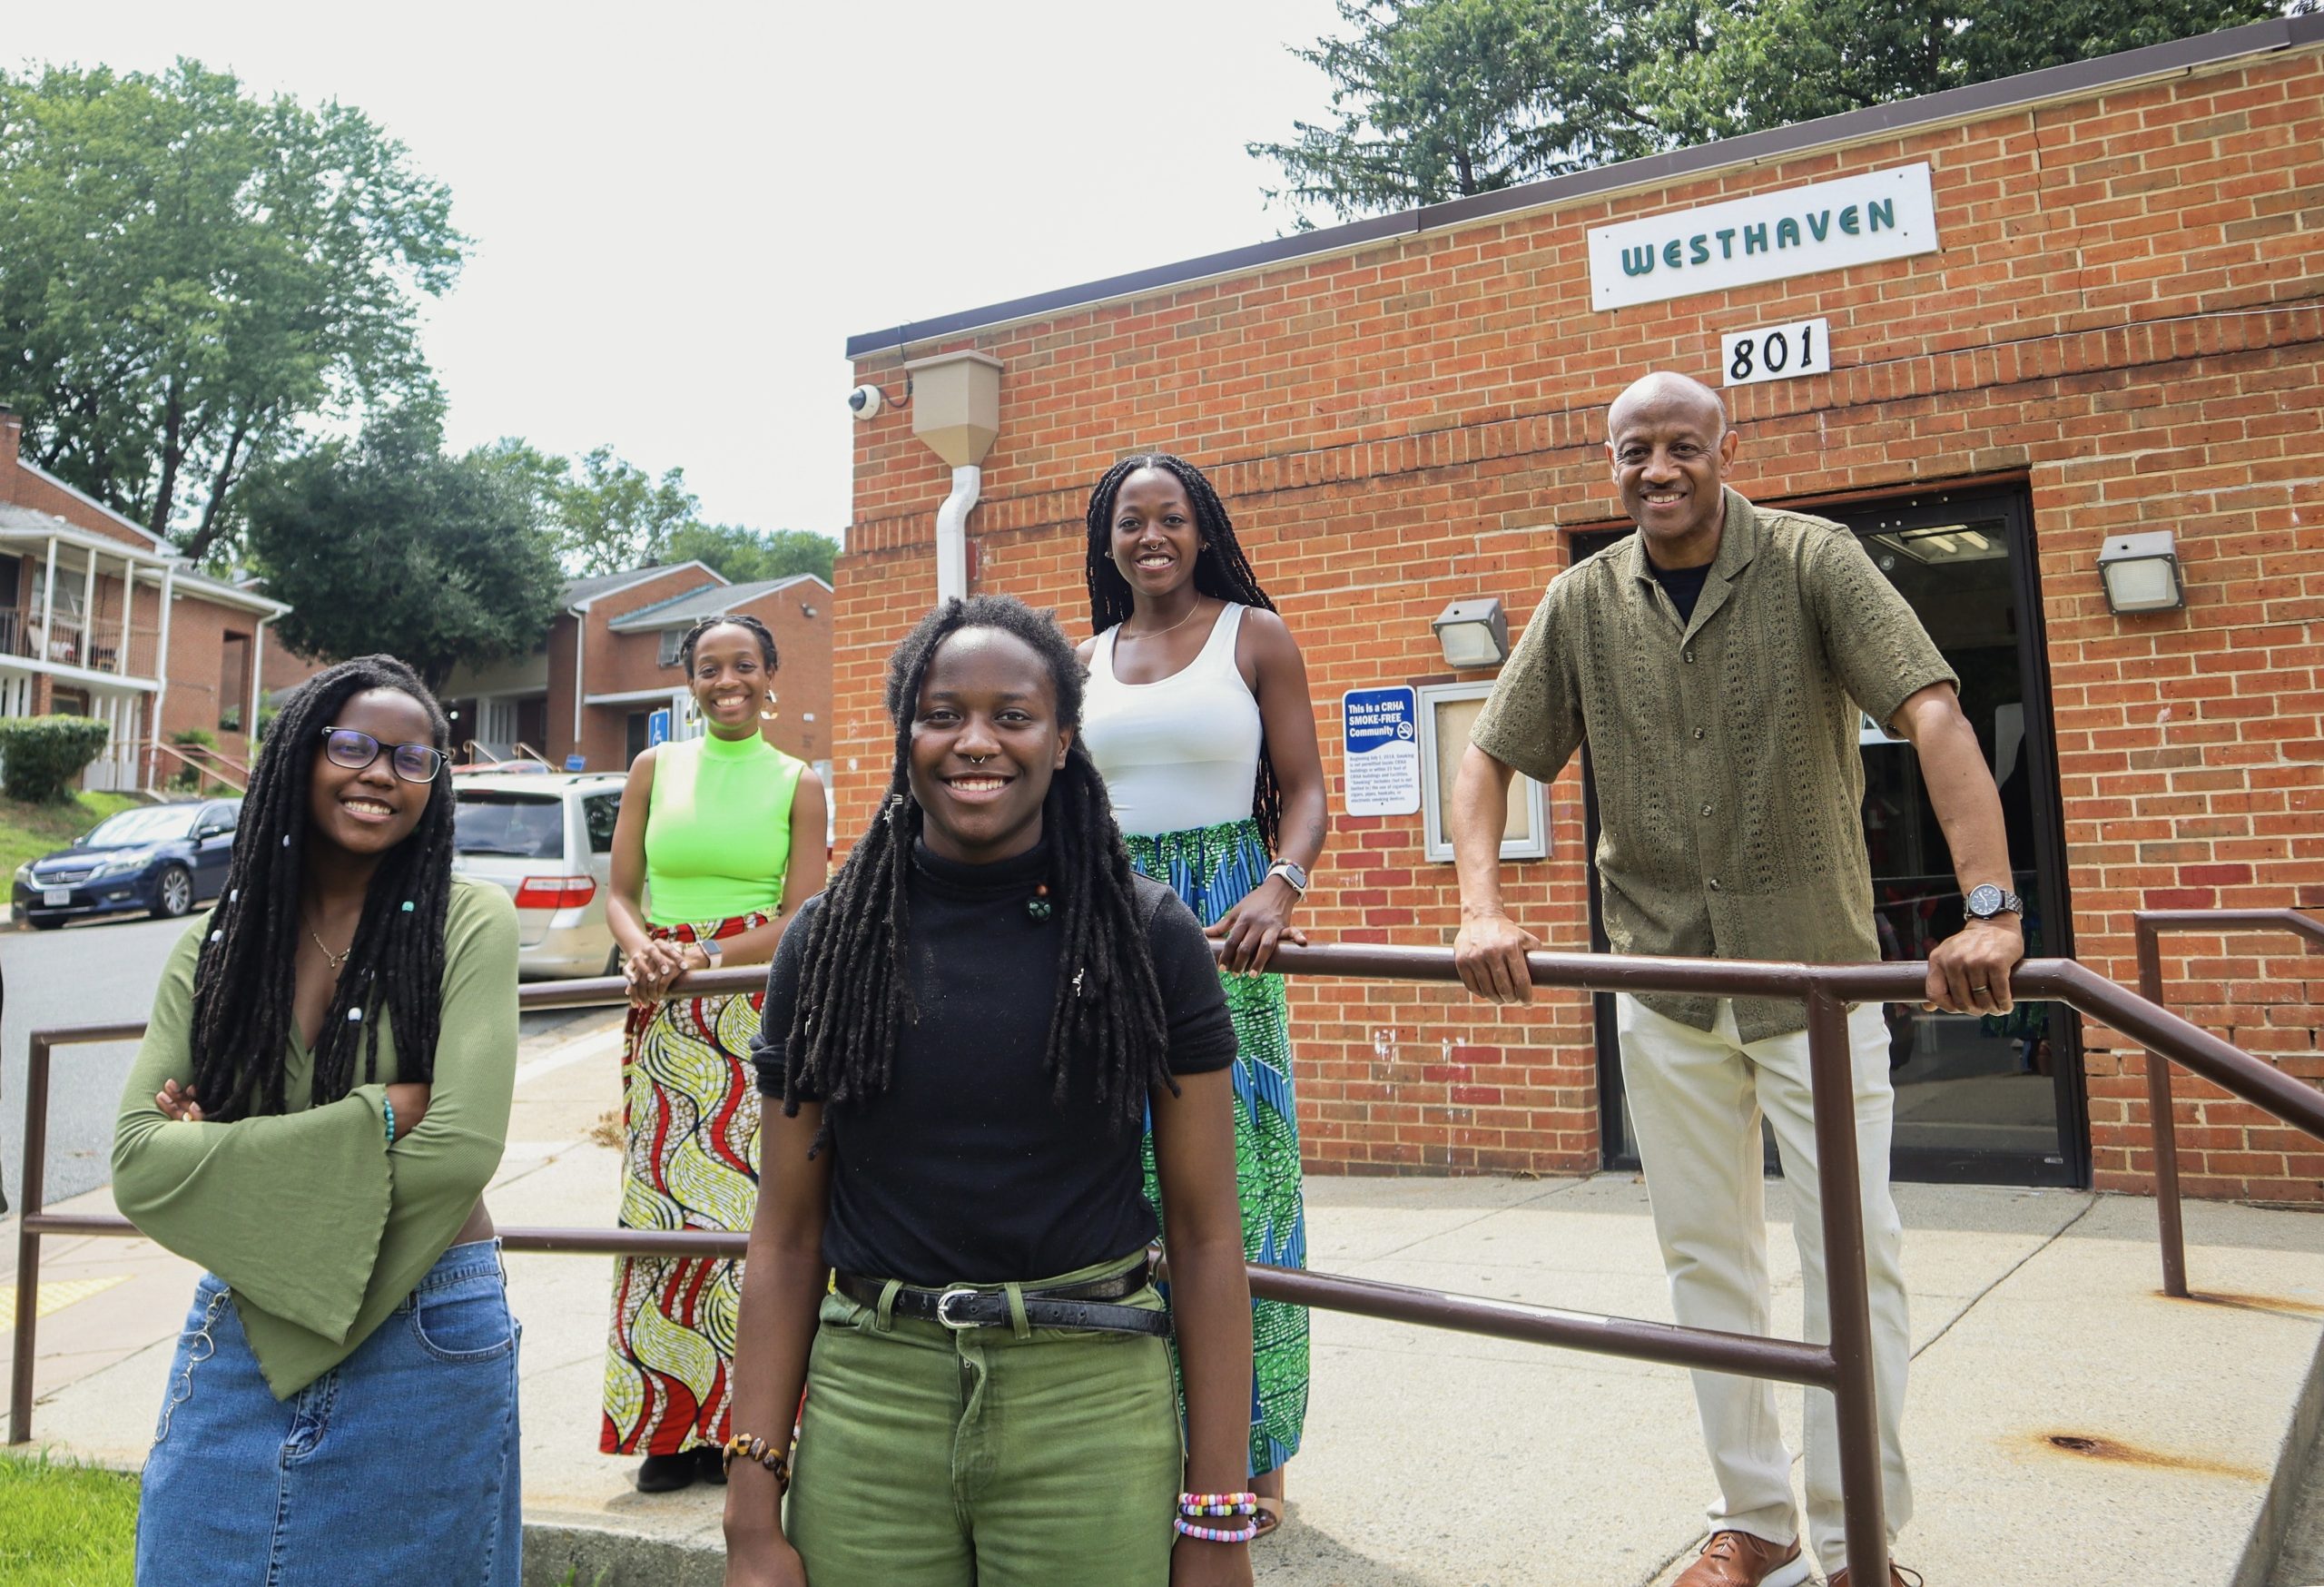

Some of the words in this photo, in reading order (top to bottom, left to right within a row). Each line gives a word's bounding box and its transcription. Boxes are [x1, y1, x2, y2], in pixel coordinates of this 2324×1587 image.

[1621, 197, 1896, 277] WESTHAVEN
[1729, 324, 1813, 380] 801
[1348, 704, 1364, 714] This
[1366, 703, 1373, 713] is
[1381, 701, 1404, 712] CRHA
[1349, 713, 1402, 726] SMOKE-FREE
[1350, 725, 1393, 738] Community
